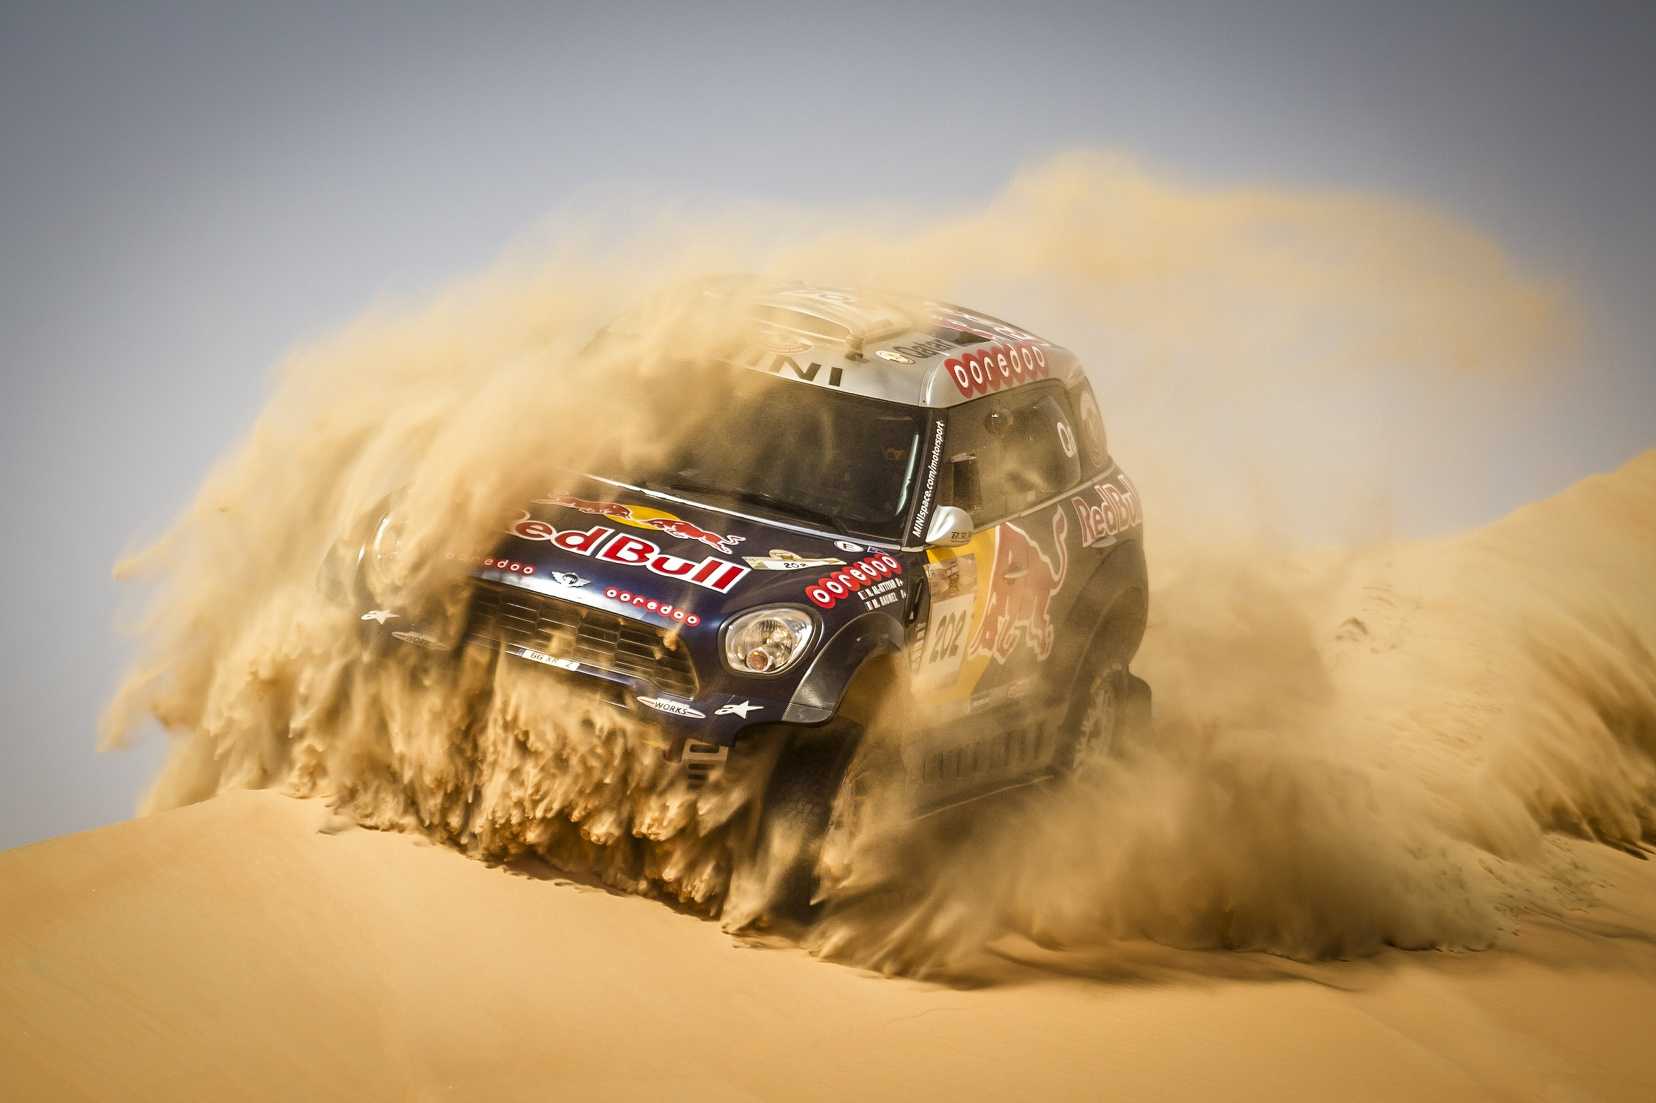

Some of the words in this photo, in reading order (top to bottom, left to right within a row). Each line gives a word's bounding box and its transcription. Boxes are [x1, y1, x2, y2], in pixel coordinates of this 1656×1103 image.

[953, 343, 1046, 388] ooredoo
[912, 420, 944, 538] MINIspace.com/motorsport
[812, 555, 898, 603] ooredoo
[606, 589, 697, 624] ooredoo
[655, 701, 688, 716] WORKS
